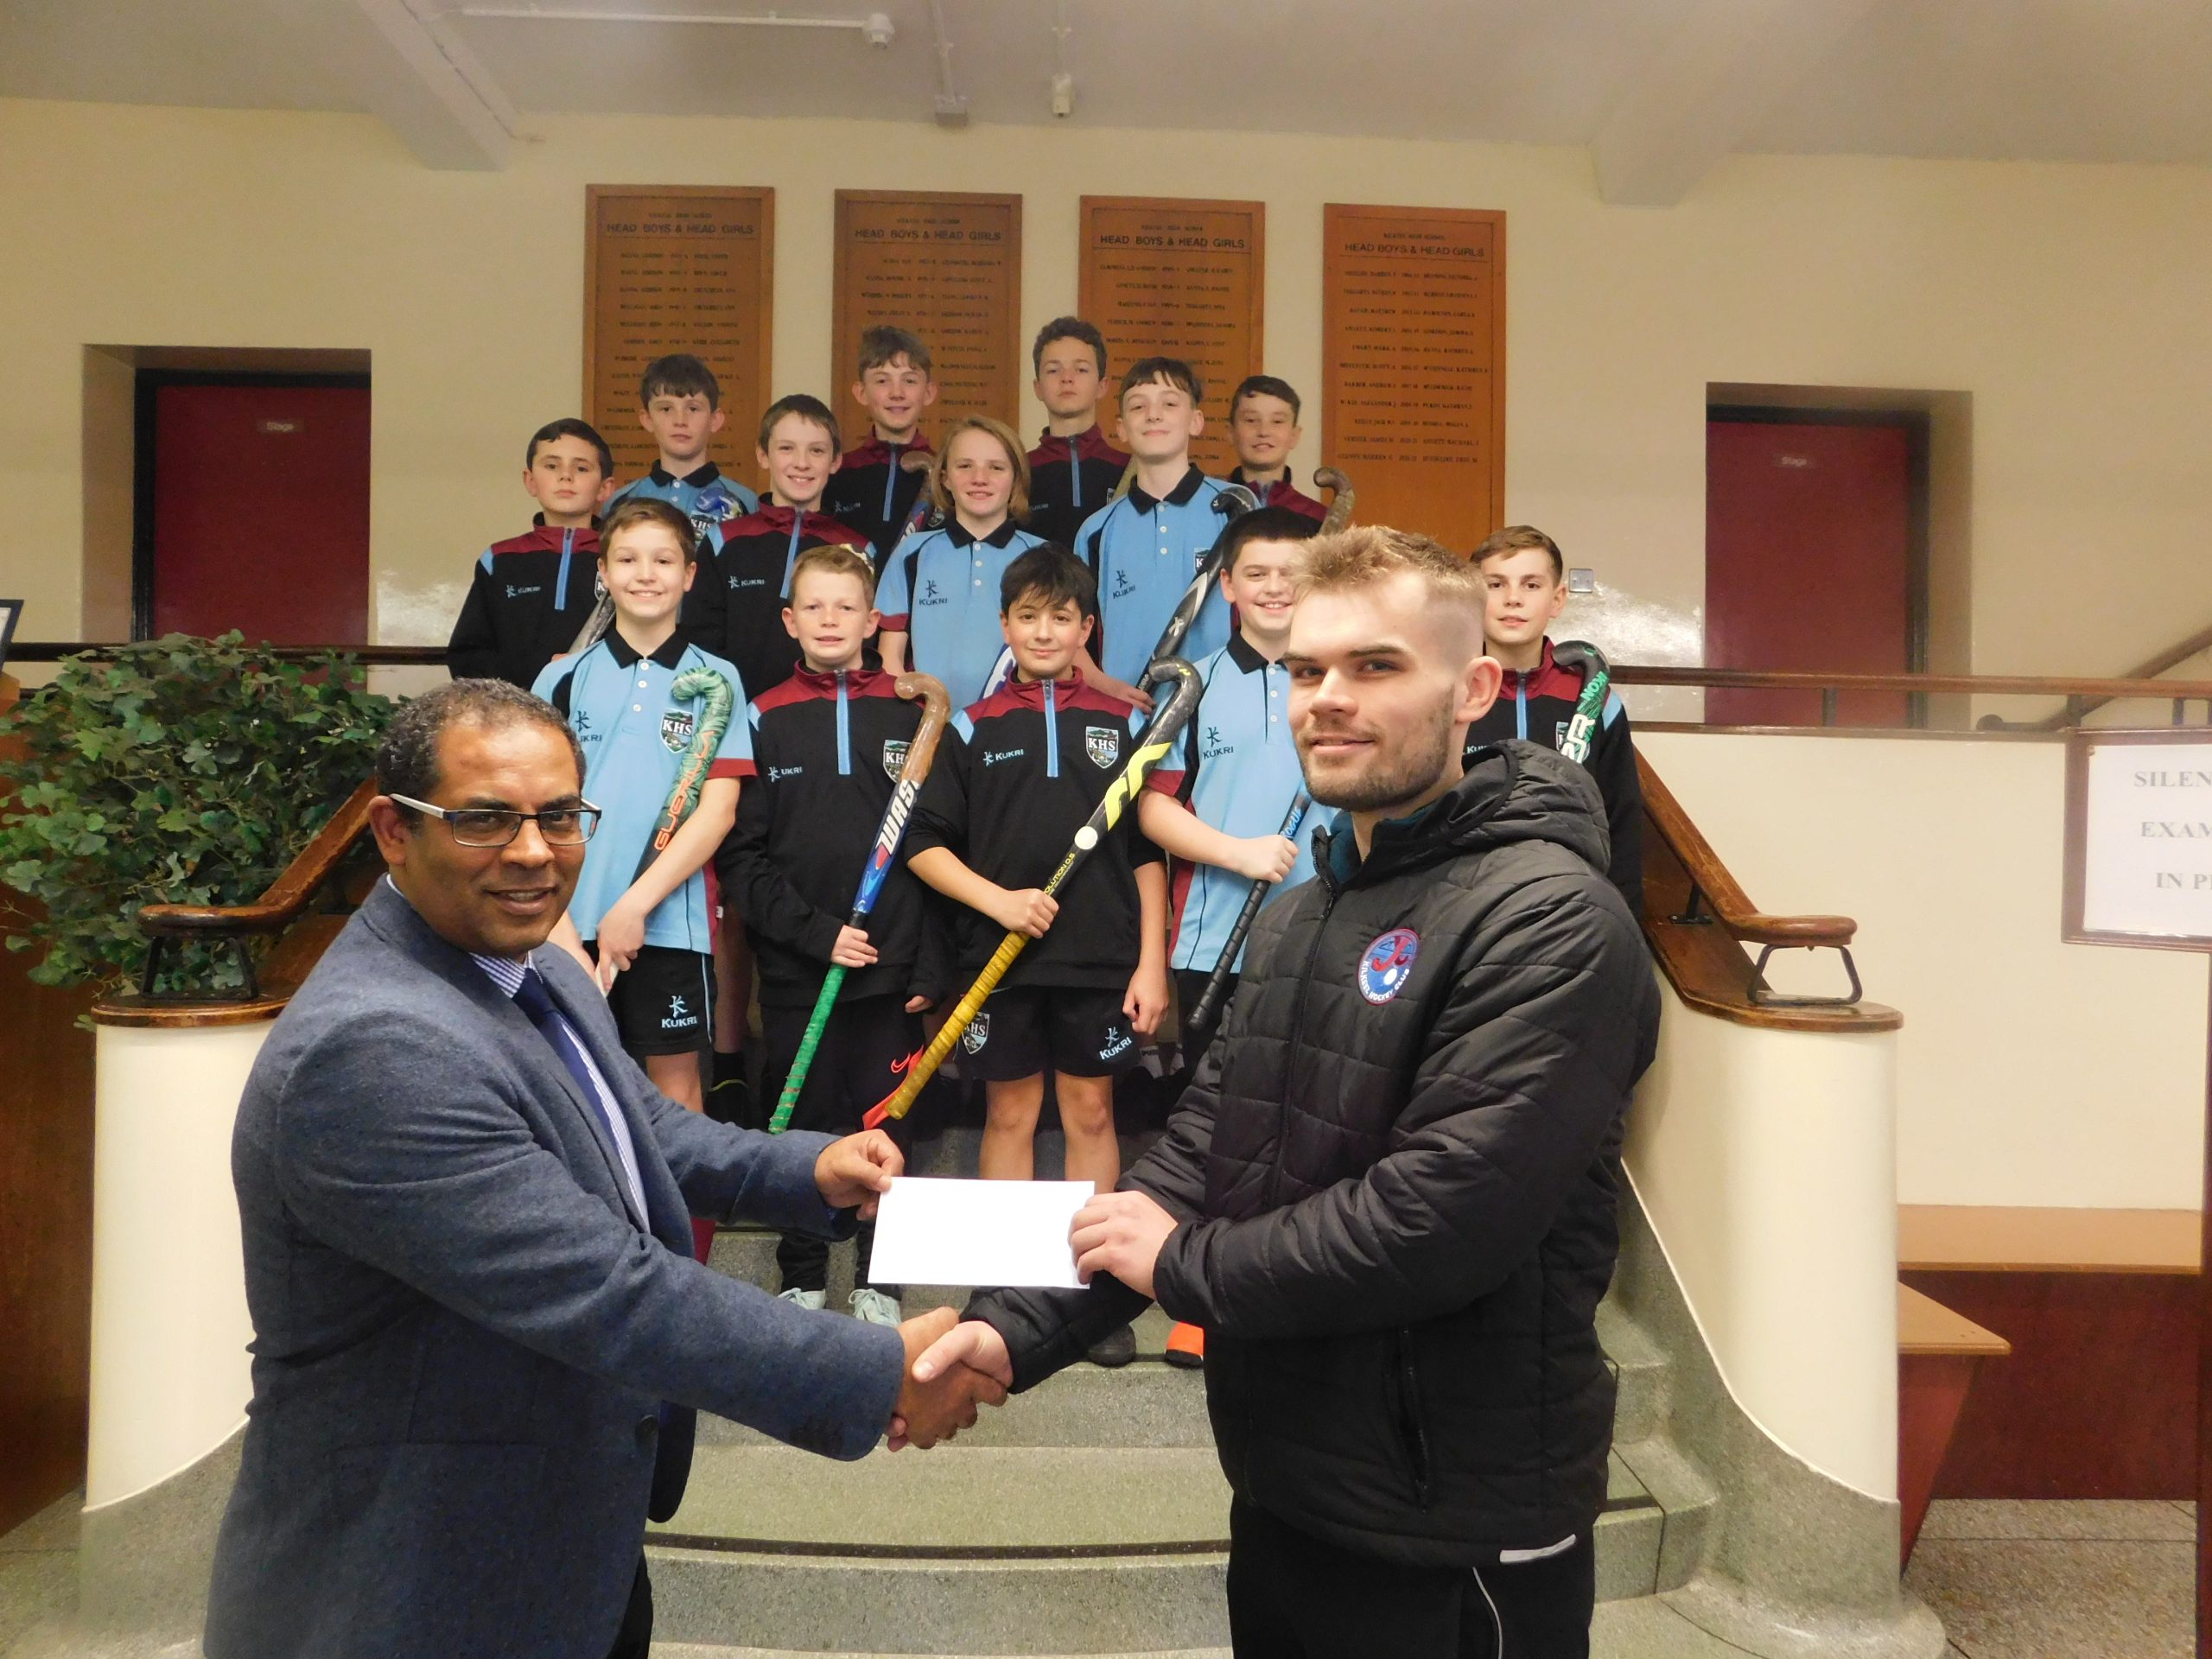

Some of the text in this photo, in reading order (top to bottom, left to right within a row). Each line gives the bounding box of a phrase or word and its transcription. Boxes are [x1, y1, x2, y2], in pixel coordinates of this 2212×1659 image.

[607, 224, 754, 234] HEAD BOYS & HEAD GIRLS
[855, 229, 1001, 240] HEAD BOYS & HEAD GIRLS
[1100, 235, 1245, 249] HEAD BOYS & HEAD GIRLS
[1344, 243, 1484, 257] HEAD BOYS & HEAD GIRLS
[662, 719, 693, 736] KHS
[1088, 738, 1116, 751] KHS
[885, 752, 908, 765] KH
[995, 749, 1025, 761] KUKRI
[1203, 746, 1234, 760] KUKRI
[1044, 864, 1066, 893] OLUTION
[2156, 873, 2212, 889] IN P
[1360, 961, 1410, 1001] KILKEEL HOCKEY CLUB
[661, 1016, 698, 1028] KUKRI
[1099, 1036, 1132, 1060] KUKRI
